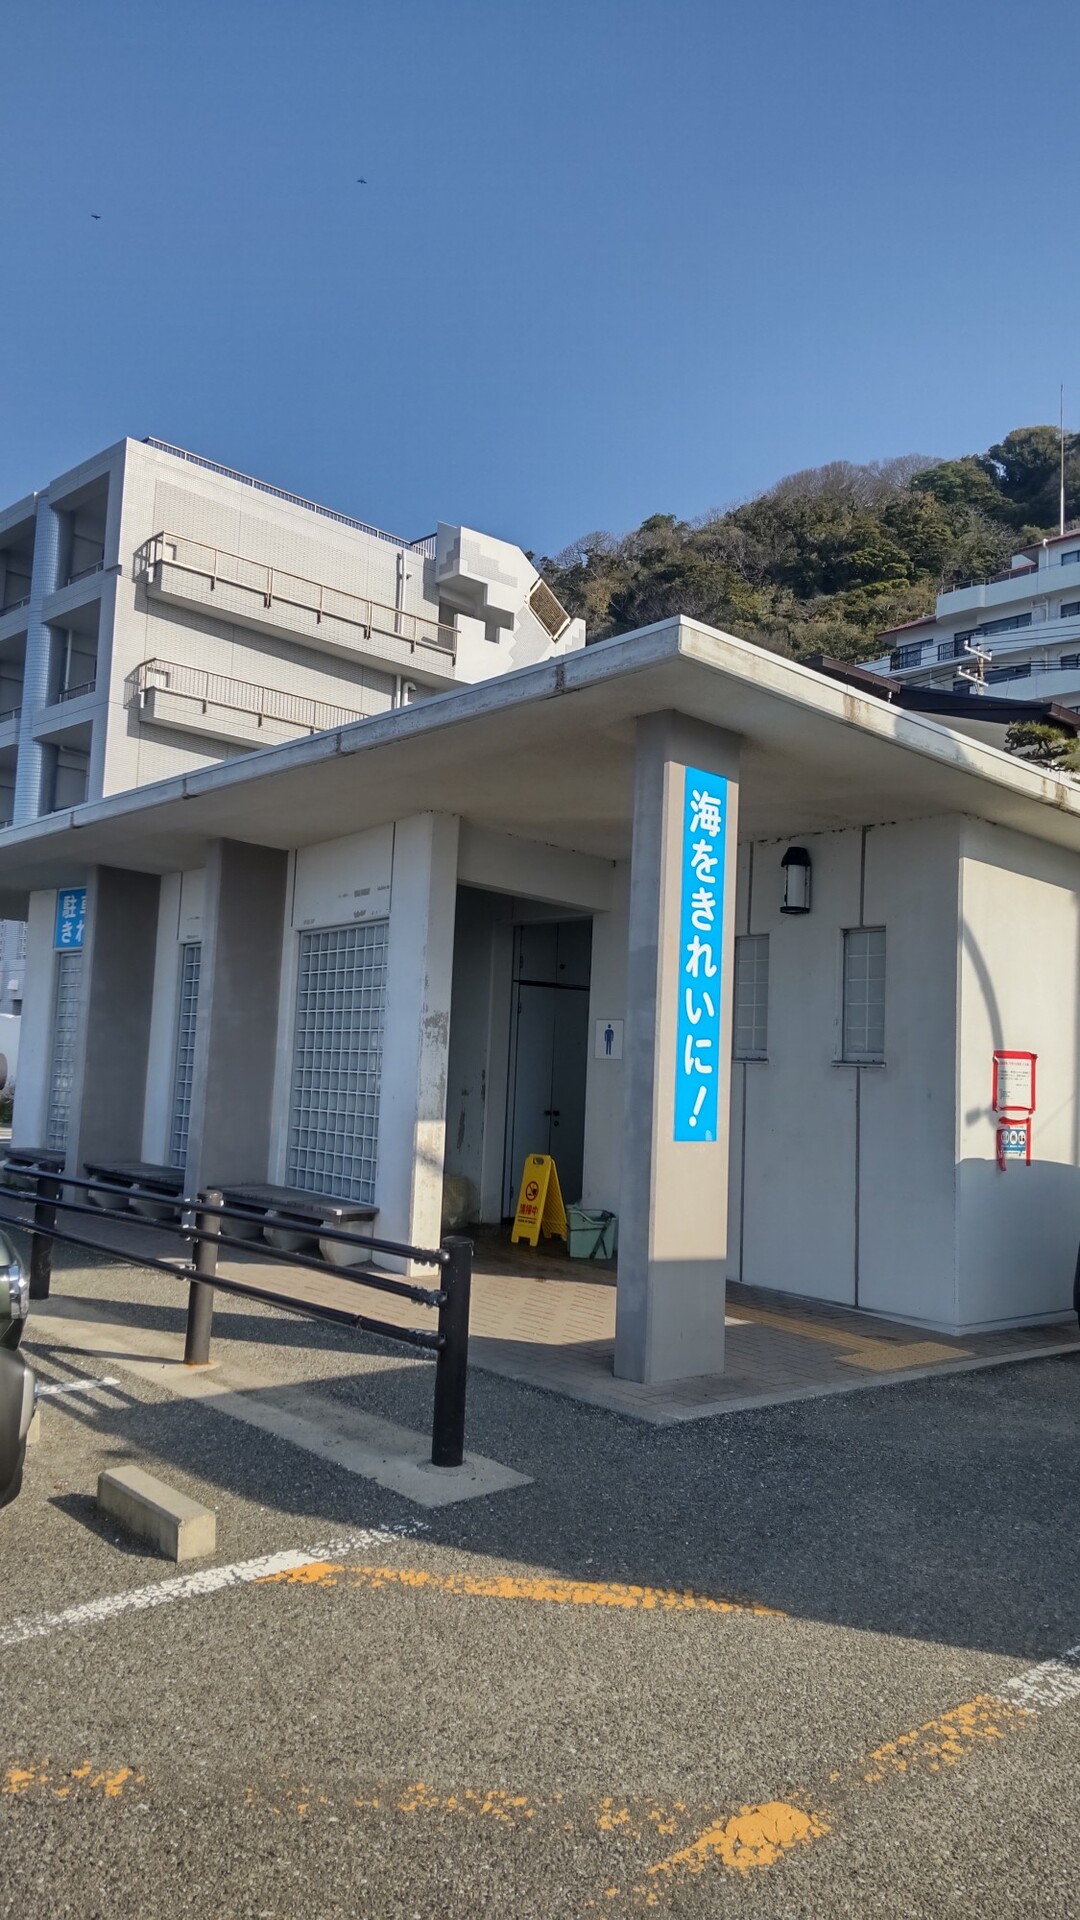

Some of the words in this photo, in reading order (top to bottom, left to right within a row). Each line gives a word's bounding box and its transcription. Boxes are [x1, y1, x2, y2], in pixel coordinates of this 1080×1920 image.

[684, 789, 721, 1127] 海をきれいに!
